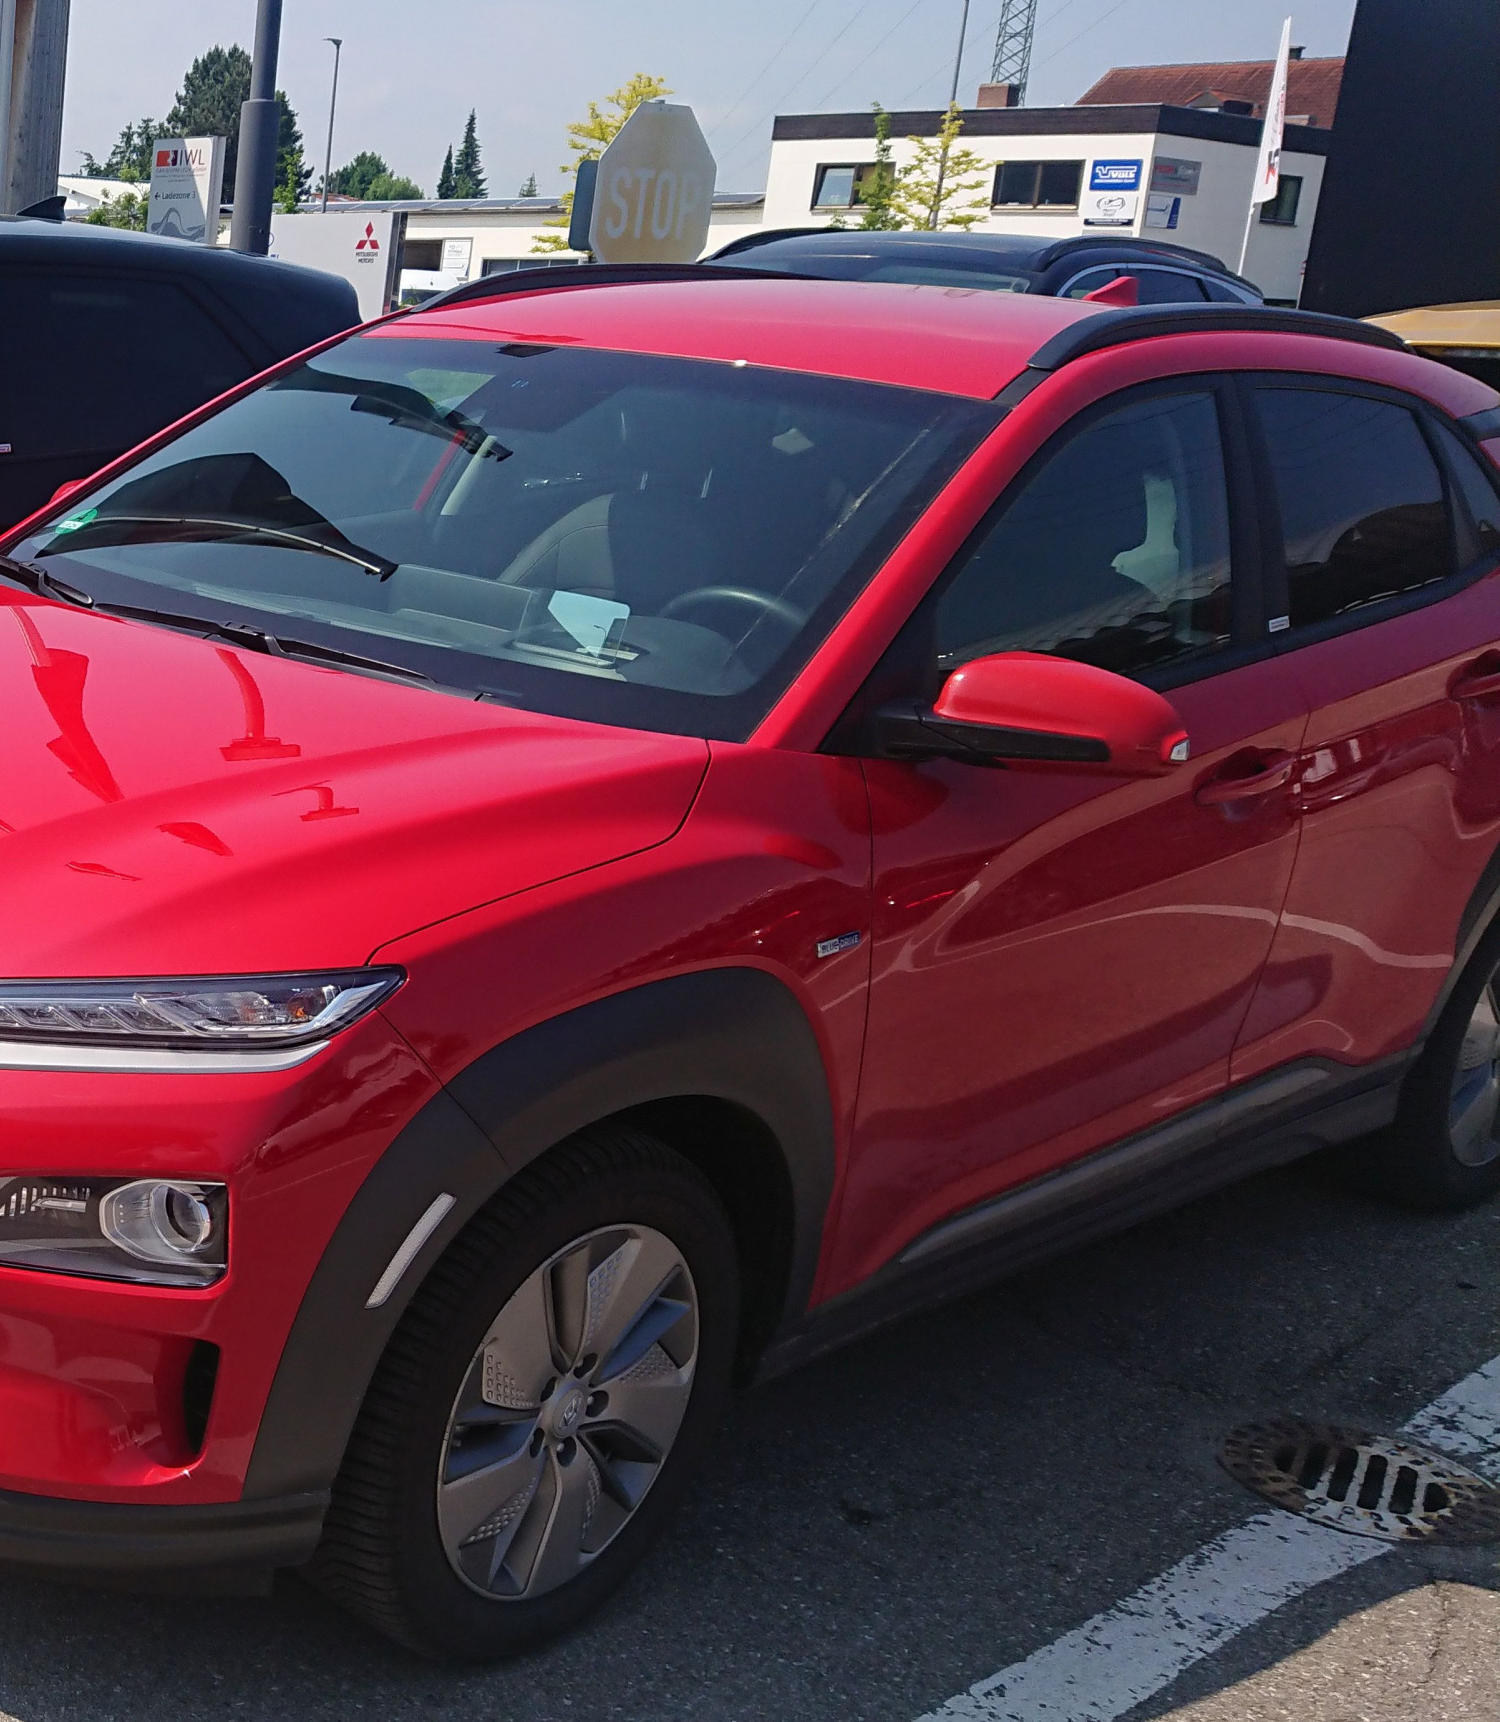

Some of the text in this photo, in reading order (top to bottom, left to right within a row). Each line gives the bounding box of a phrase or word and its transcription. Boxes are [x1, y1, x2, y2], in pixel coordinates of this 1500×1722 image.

[180, 149, 205, 166] IWL
[162, 192, 190, 200] Ladezone
[605, 166, 700, 240] STOP
